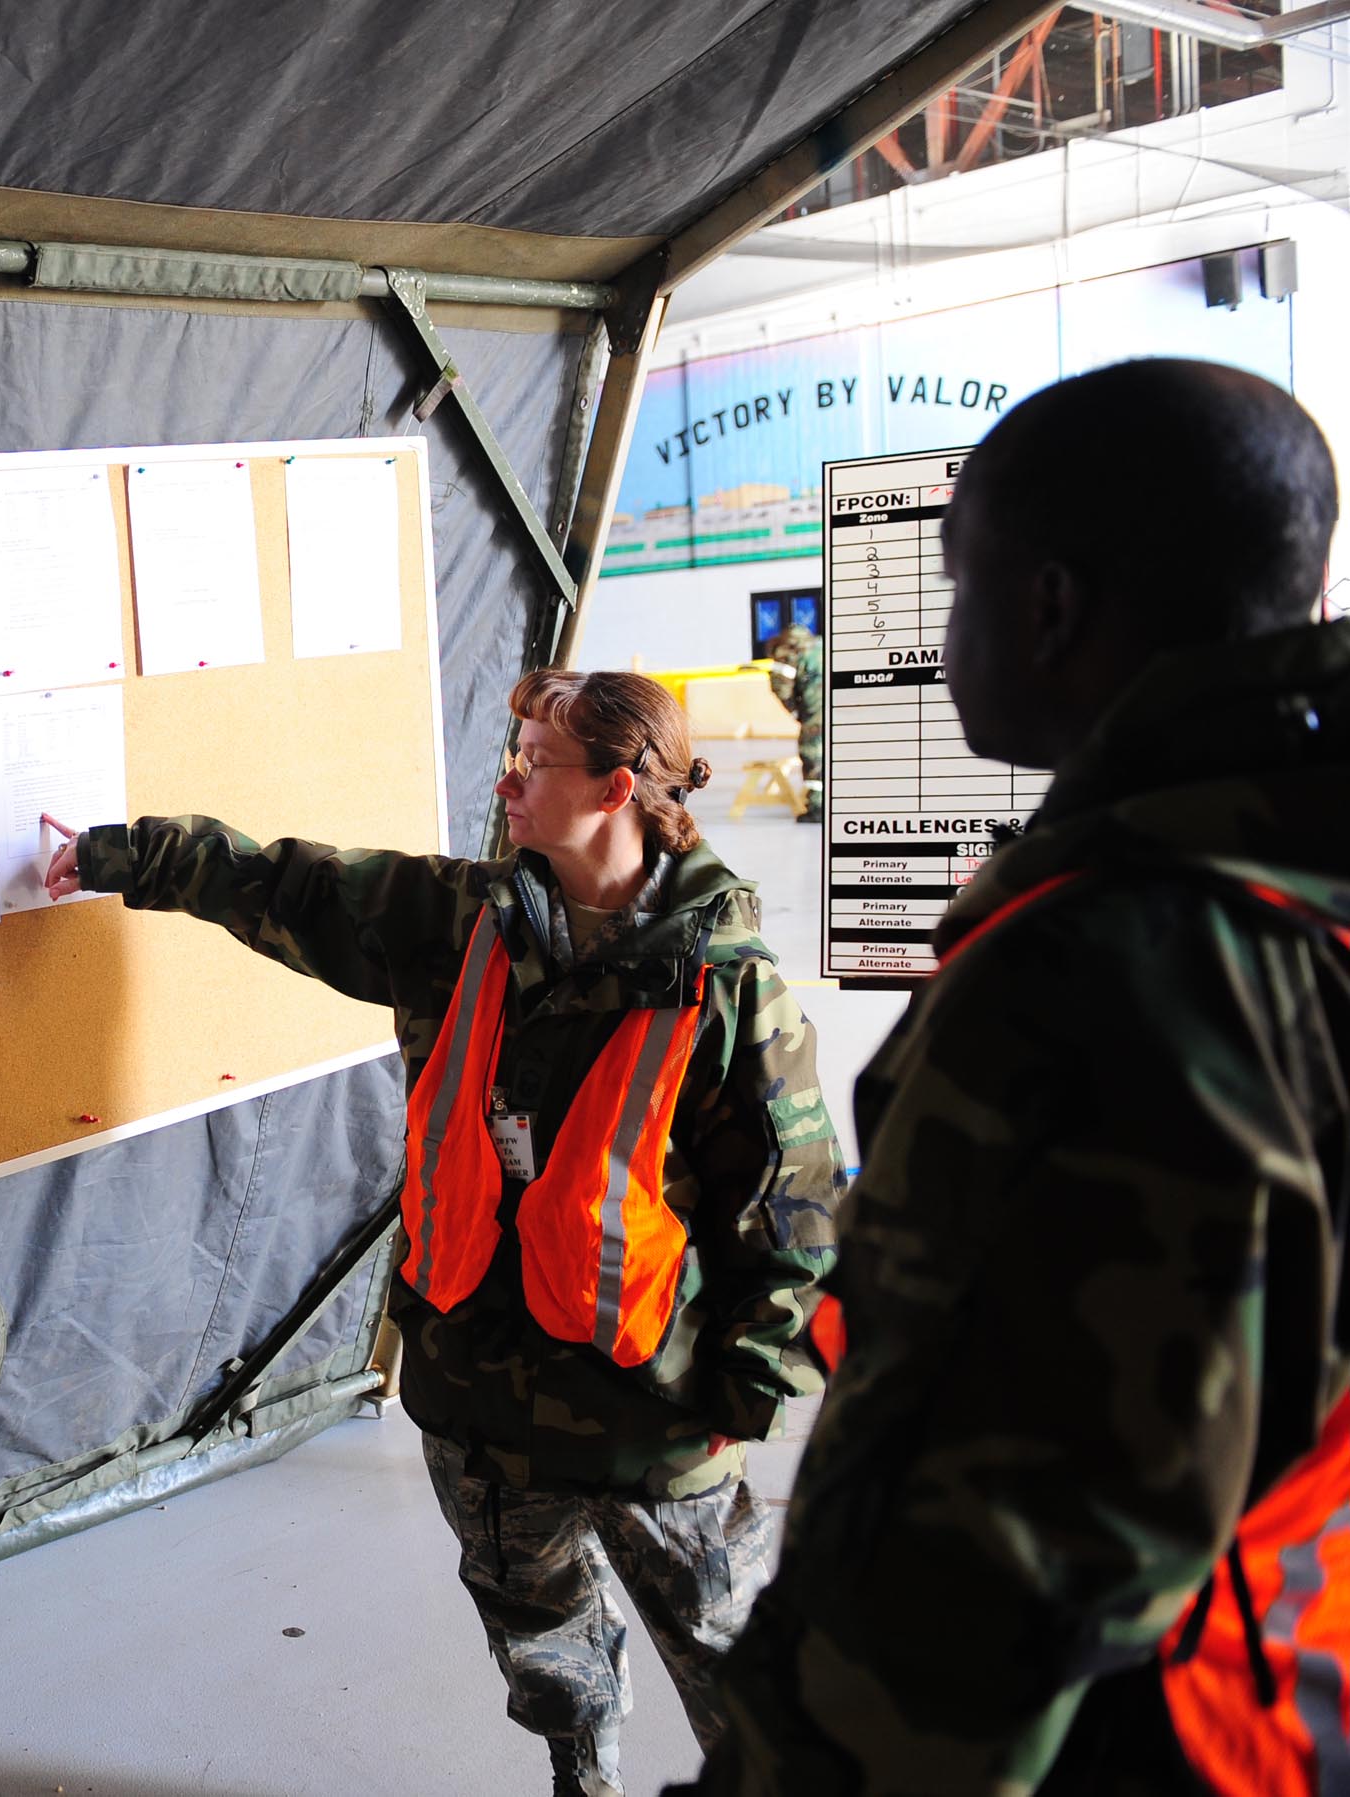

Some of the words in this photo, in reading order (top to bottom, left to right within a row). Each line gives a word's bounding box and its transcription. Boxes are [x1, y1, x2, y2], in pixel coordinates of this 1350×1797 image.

[655, 387, 794, 466] VICTORY
[817, 377, 859, 409] BY
[887, 375, 1008, 412] VALOR
[836, 493, 911, 512] FPCON:
[859, 513, 889, 524] Zone
[866, 546, 879, 561] 2
[866, 563, 880, 578] 3
[867, 582, 878, 593] 4
[868, 599, 881, 611] 5
[873, 616, 885, 628] 6
[871, 633, 886, 646] 7
[854, 672, 894, 684] BLDG#
[843, 818, 998, 835] CHALLENGES
[863, 859, 908, 870] Primary
[859, 874, 912, 883] Alternate
[862, 902, 907, 912] Primary
[859, 918, 912, 927] Alternate
[862, 944, 907, 955] Primary
[858, 959, 911, 968] Alternate
